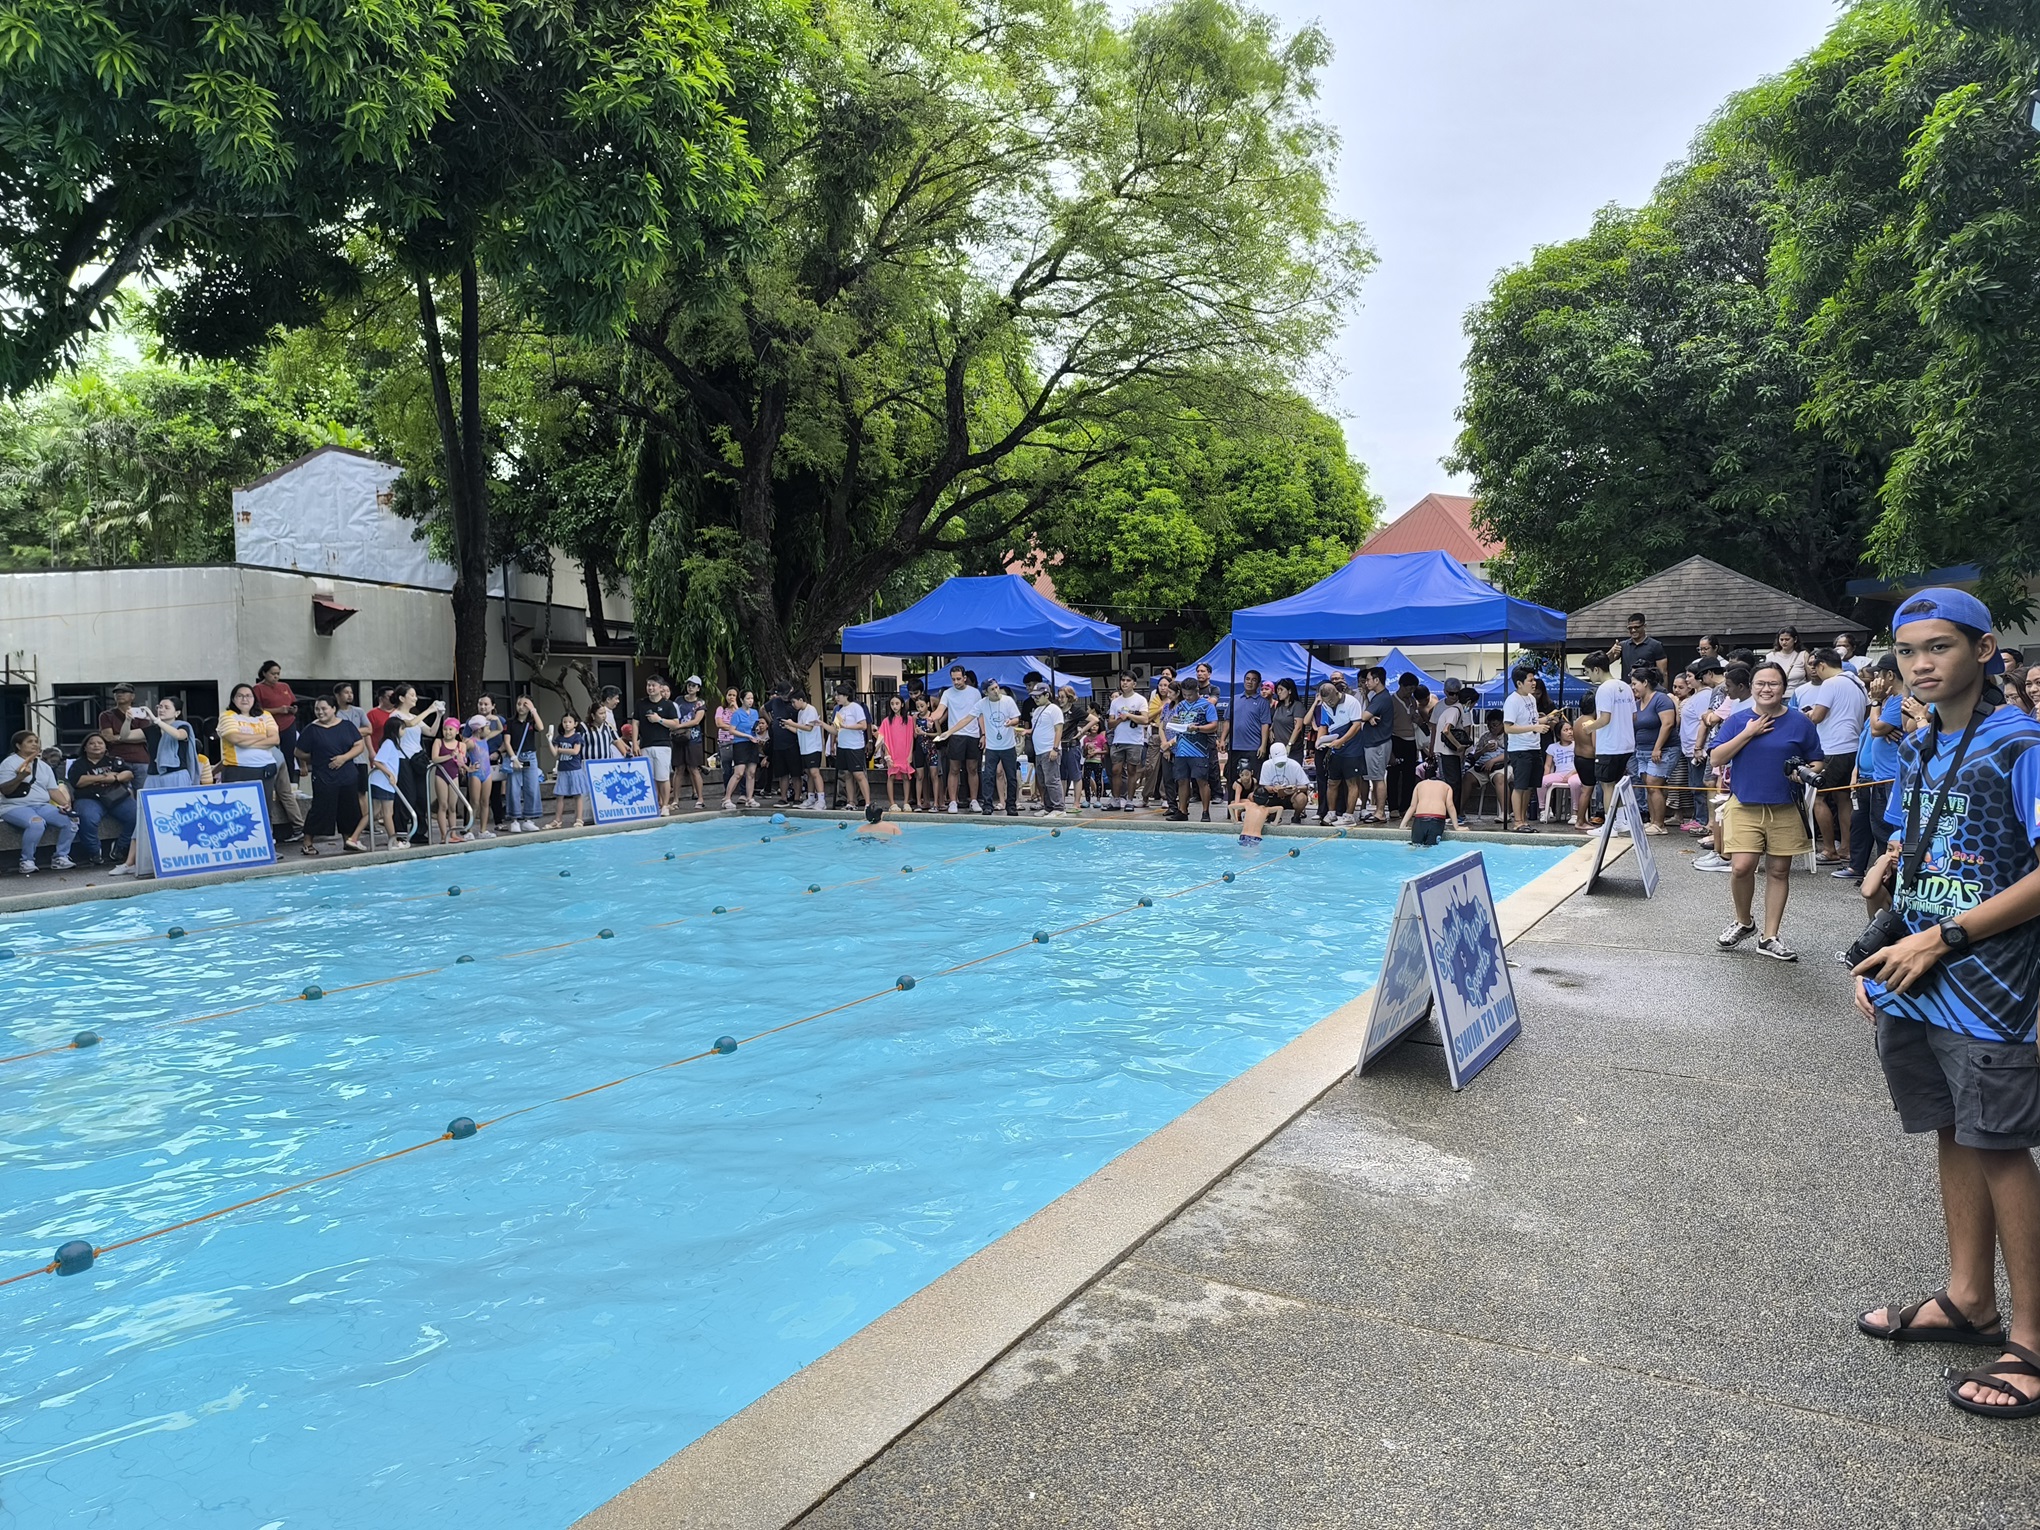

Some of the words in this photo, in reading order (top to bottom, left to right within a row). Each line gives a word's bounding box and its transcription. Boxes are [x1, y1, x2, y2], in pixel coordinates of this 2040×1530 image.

[593, 769, 622, 793] Splash
[620, 770, 645, 788] Dash
[616, 785, 643, 805] Sports
[155, 801, 208, 834] Splash
[209, 800, 252, 826] Dash
[599, 807, 624, 819] SWIM
[625, 806, 637, 816] TO
[638, 804, 656, 814] WIN
[197, 821, 246, 848] Sports
[161, 853, 209, 869] SWIM
[212, 850, 233, 862] TO
[236, 846, 268, 860] WIN
[1952, 850, 1985, 865] 2018
[1907, 899, 1945, 916] SWIMMING
[1435, 902, 1464, 980] Splash
[1463, 895, 1488, 949] Dash
[1465, 948, 1491, 1006] Sports
[1453, 1020, 1485, 1064] SWIM
[1480, 1011, 1496, 1037] TO
[1492, 993, 1514, 1028] WIN
